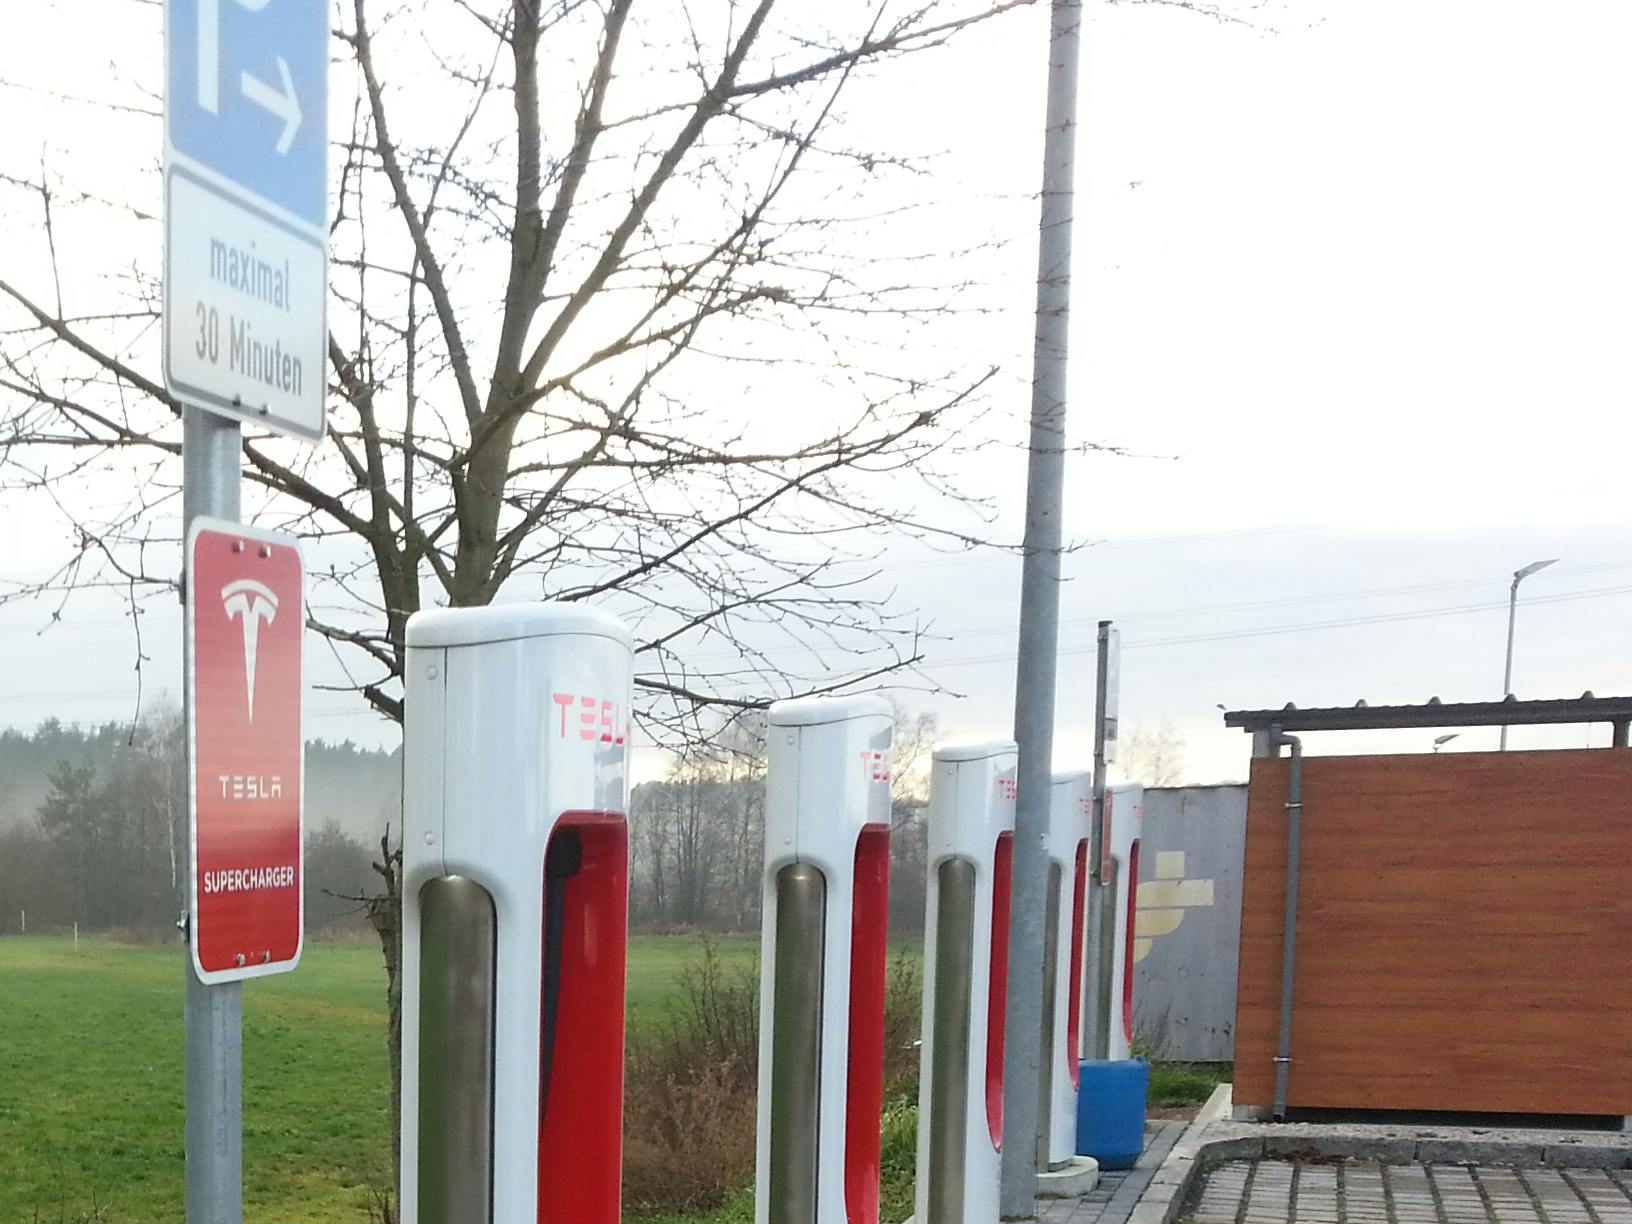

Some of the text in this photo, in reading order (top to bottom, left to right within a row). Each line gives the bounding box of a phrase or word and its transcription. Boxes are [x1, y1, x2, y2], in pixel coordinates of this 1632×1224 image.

[210, 238, 290, 312] maximal
[196, 301, 302, 397] 30 Minuten
[553, 693, 630, 744] TESL
[219, 775, 282, 799] TESLA
[204, 866, 294, 893] SUPERCHARGER
